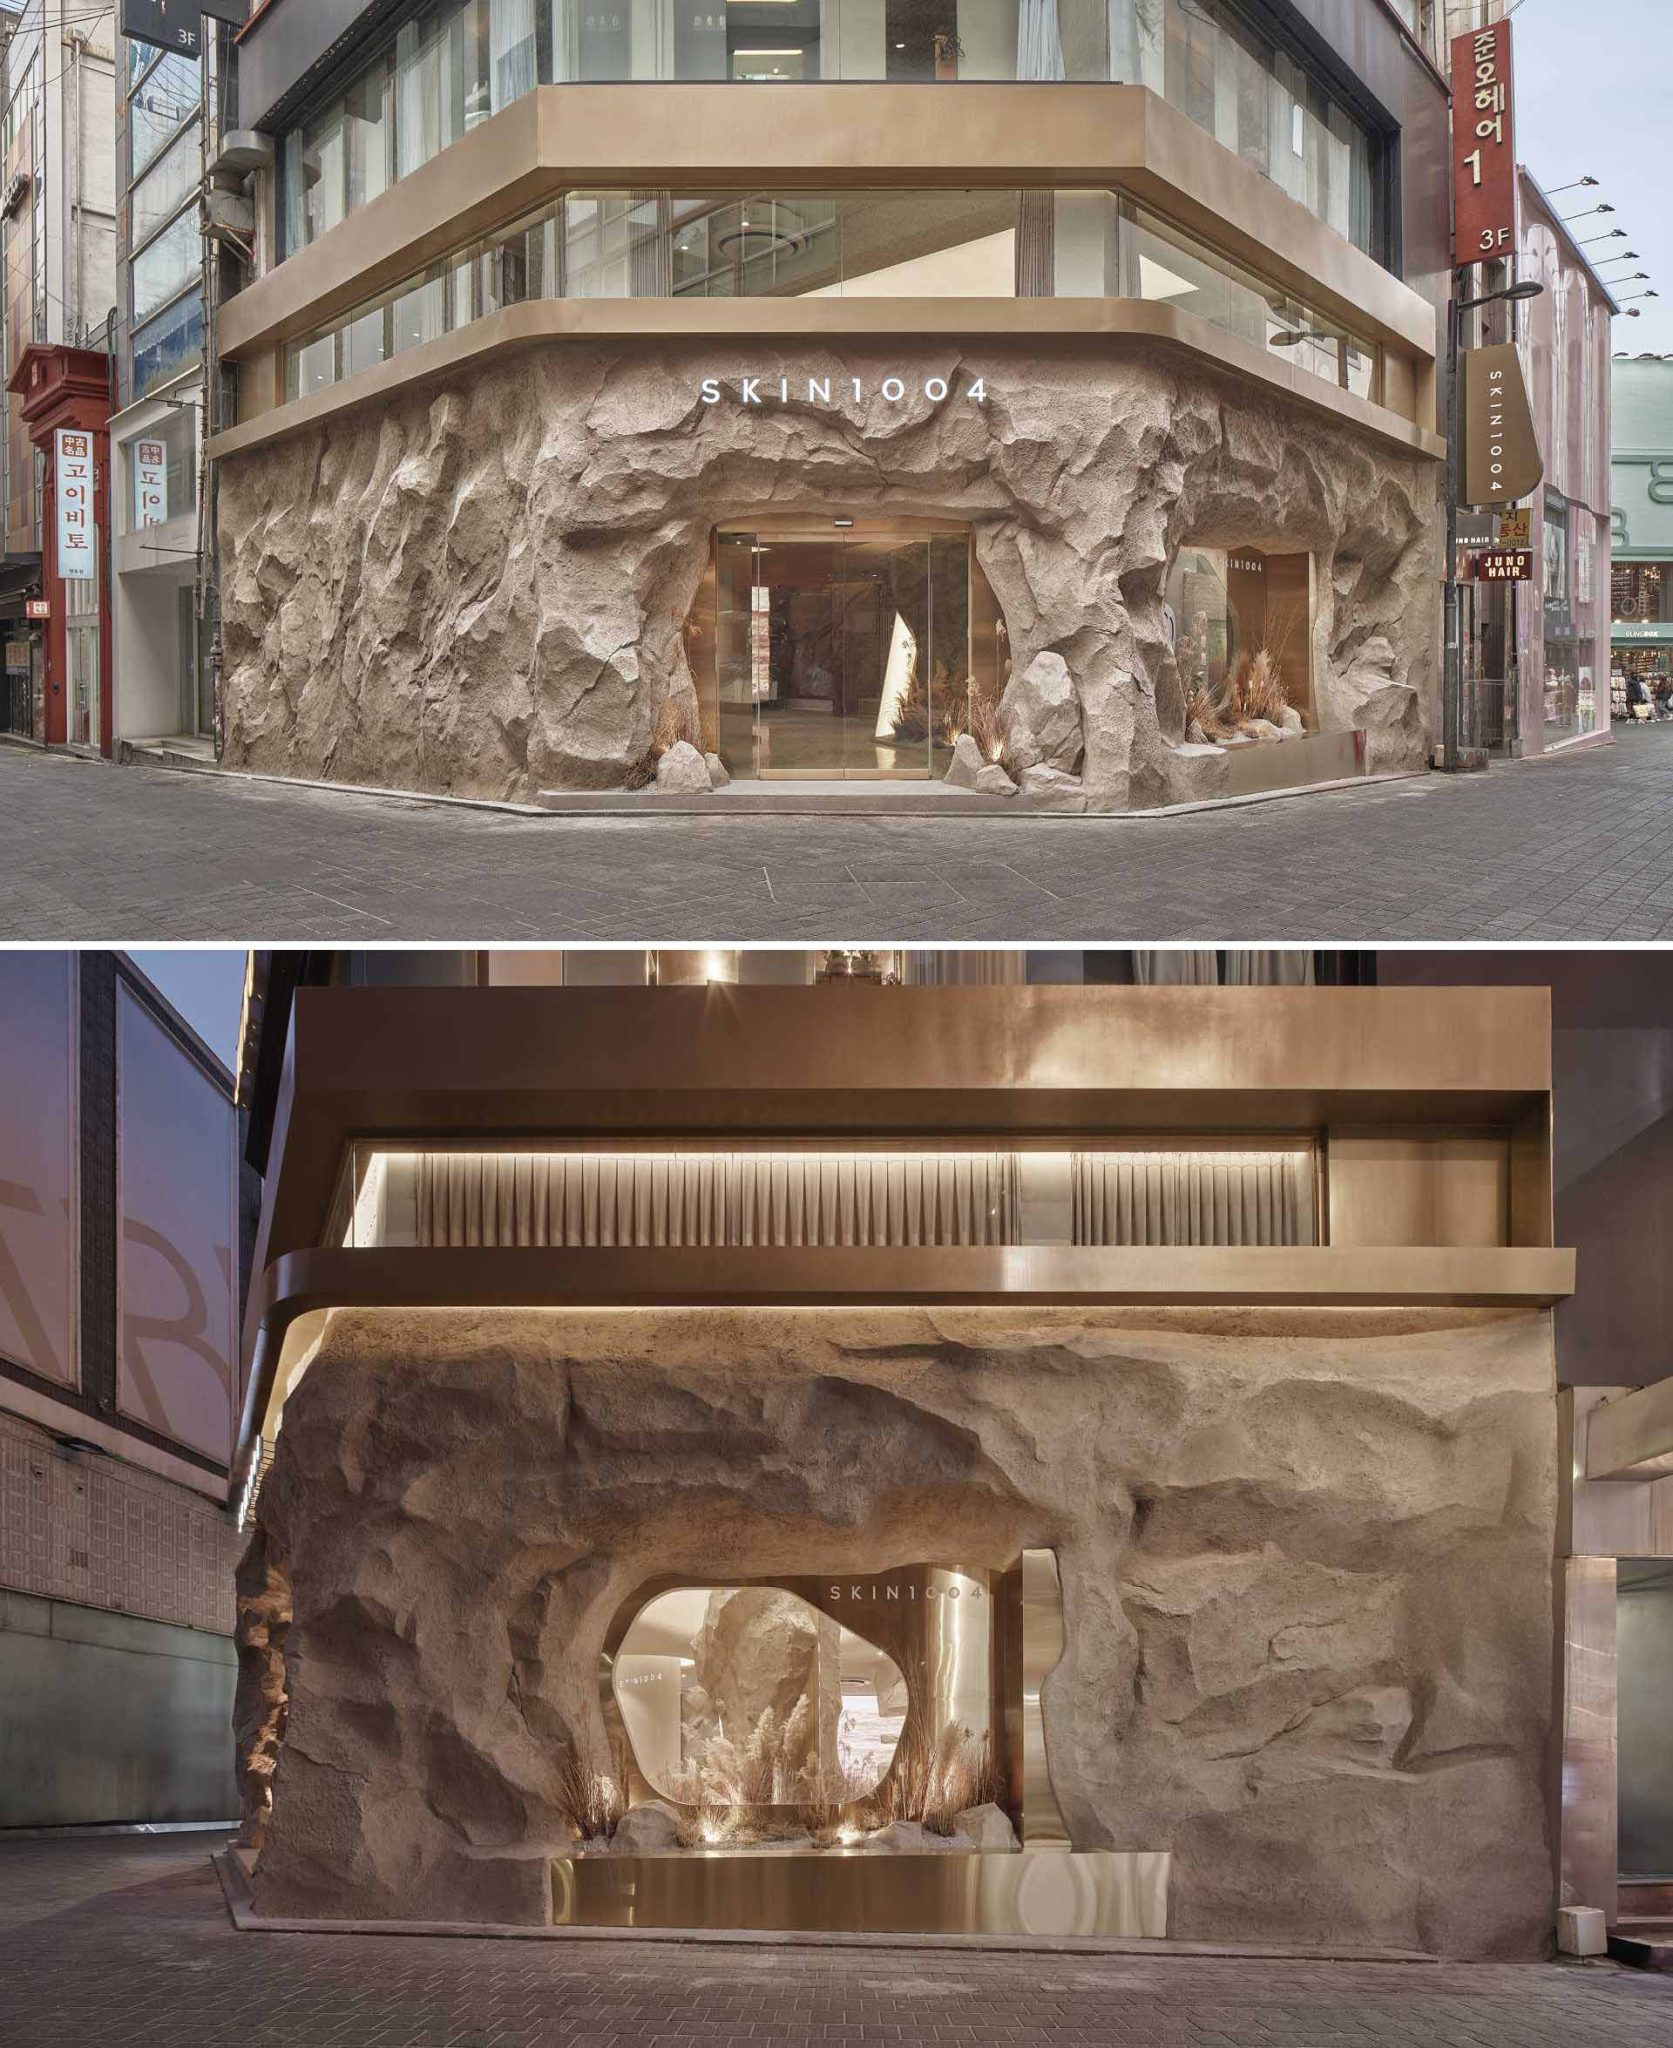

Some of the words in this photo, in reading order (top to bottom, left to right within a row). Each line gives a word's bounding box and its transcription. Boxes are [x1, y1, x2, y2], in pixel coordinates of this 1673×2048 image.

[178, 29, 196, 46] 3F
[1474, 30, 1506, 144] 준오헤어
[1463, 148, 1482, 186] 1
[1479, 227, 1511, 251] 3F
[700, 376, 988, 404] SKIN1004
[1489, 369, 1503, 491] SKIN1004
[64, 463, 88, 550] 고이비토
[1470, 536, 1490, 544] HAIR
[1500, 523, 1528, 537] 동산
[1485, 555, 1525, 567] JUNO
[1488, 566, 1521, 578] HAIR
[830, 1585, 982, 1600] SKIN1004
